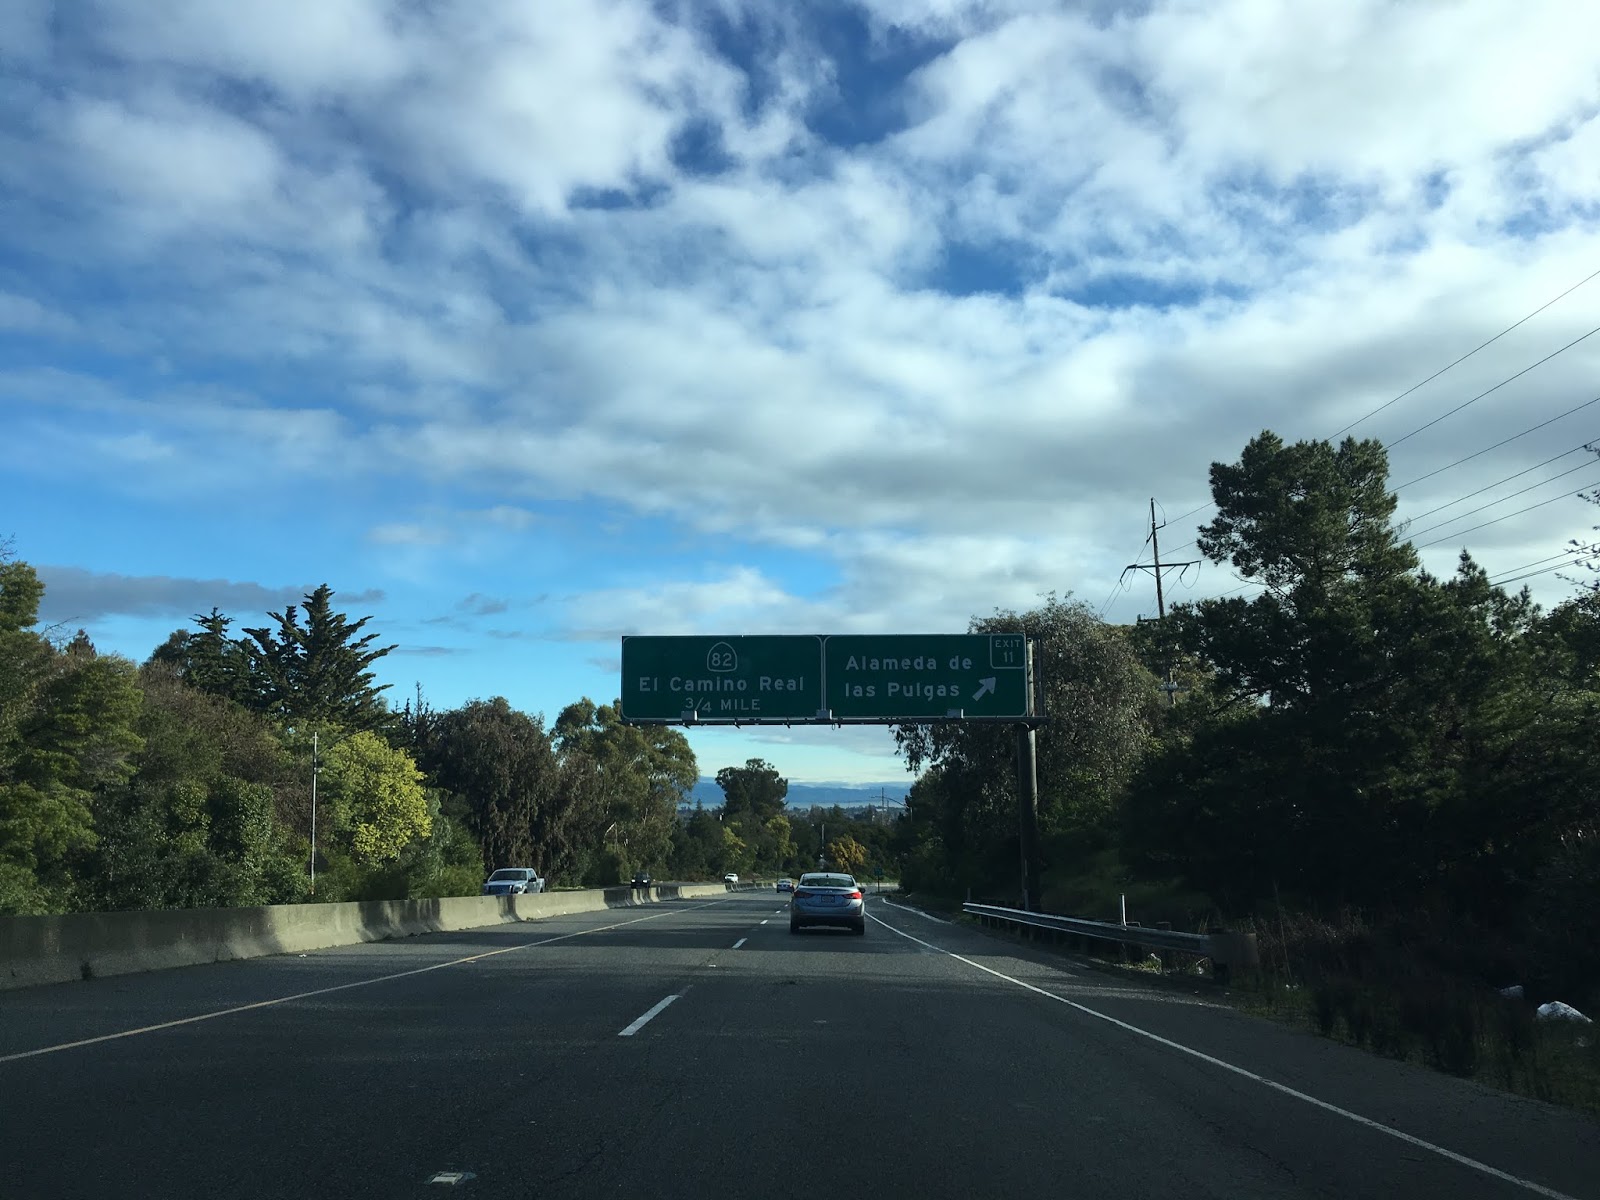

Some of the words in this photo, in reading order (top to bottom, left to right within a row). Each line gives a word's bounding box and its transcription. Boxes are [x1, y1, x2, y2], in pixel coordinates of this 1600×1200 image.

[995, 639, 1021, 648] EXIT
[711, 652, 732, 667] 82
[845, 655, 937, 671] Alameda
[949, 655, 973, 670] de
[1003, 651, 1014, 663] 11
[639, 677, 658, 692] El
[670, 676, 747, 692] Camino
[759, 676, 804, 692] Real
[845, 682, 876, 697] las
[888, 682, 960, 701] Pulgas
[685, 697, 712, 713] 3/4
[720, 699, 760, 711] MILE
